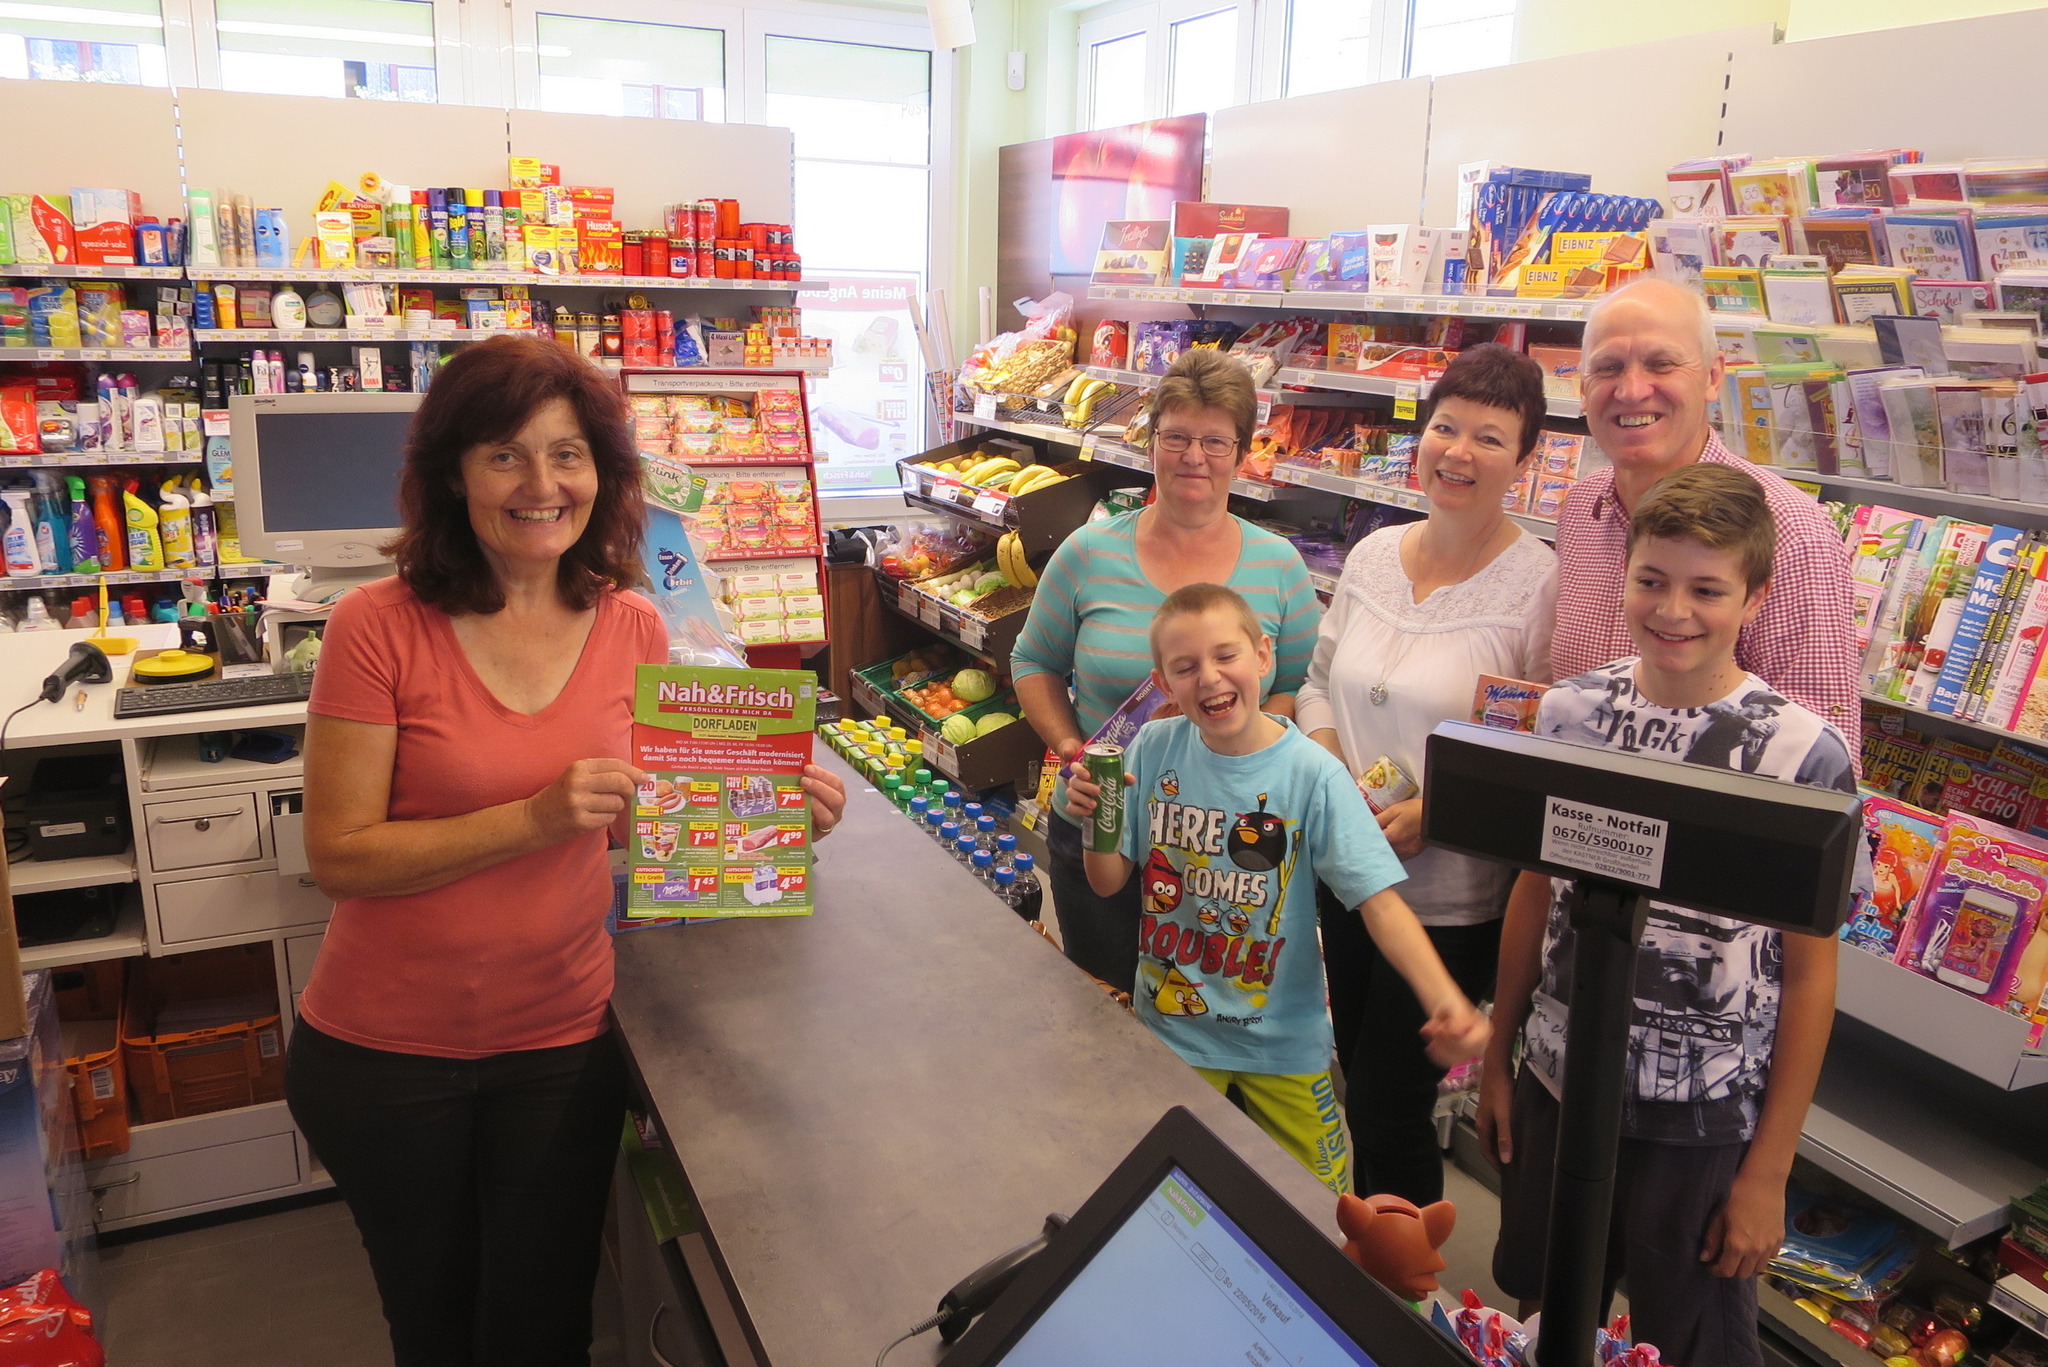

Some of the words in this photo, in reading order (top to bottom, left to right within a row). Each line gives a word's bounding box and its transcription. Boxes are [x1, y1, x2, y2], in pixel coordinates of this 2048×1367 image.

[1744, 186, 1760, 200] 55
[1863, 181, 1881, 199] 50
[1218, 210, 1246, 223] Suchard
[586, 220, 613, 231] Husch
[80, 240, 128, 249] spezial-salz
[1843, 232, 1864, 248] 85
[1933, 228, 1955, 246] 80
[2028, 230, 2048, 249] 75
[1558, 239, 1594, 253] LEIBNIZ
[1909, 244, 1935, 254] Zum
[1900, 247, 1960, 266] Geburtstag
[2001, 249, 2028, 259] Zum
[1990, 253, 2048, 273] Geburtsta
[1524, 268, 1558, 285] LEIBNIZ
[1916, 290, 1962, 309] Schuhe!
[711, 333, 715, 341] 4
[1340, 333, 1358, 343] soft
[256, 365, 267, 375] Fa
[363, 378, 380, 386] DIANA
[653, 379, 724, 388] Transportverpackung
[729, 380, 744, 388] Bitte
[1396, 405, 1415, 414] TIEFPREIS
[647, 464, 680, 484] blink
[6, 535, 25, 544] BLUE
[129, 532, 147, 540] BLUE
[130, 538, 148, 547] STAR
[7, 541, 26, 550] STAR
[761, 562, 795, 570] entfernen!
[663, 576, 694, 591] Orbit
[658, 680, 794, 708] Nah&Frisch
[1484, 684, 1543, 703] Manner
[679, 706, 724, 714] PERSÖNLICH
[725, 707, 740, 715] FÜR
[692, 717, 757, 732] DORFLADEN
[1096, 714, 1127, 749] Milka
[640, 745, 654, 753] Wir
[654, 746, 678, 754] haben
[679, 746, 691, 754] für
[691, 747, 703, 755] Sie
[726, 748, 758, 757] Geschäft
[758, 749, 805, 759] modernisiert,
[642, 753, 665, 762] damit
[666, 754, 677, 762] Sie
[678, 755, 697, 763] noch
[698, 756, 735, 766] bequemer
[736, 757, 772, 765] einkaufen
[773, 758, 803, 766] können!
[1881, 742, 1924, 770] FREIZ
[1995, 750, 2048, 777] SCHLAGE
[1879, 762, 1917, 782] dire
[1952, 768, 1969, 779] NEU
[640, 780, 655, 792] 20
[726, 781, 741, 789] HIT
[1948, 786, 1970, 796] ECHO
[691, 794, 717, 803] Gratis
[1942, 799, 1966, 811] FRAU
[1945, 793, 1961, 802] DER
[1971, 793, 2018, 819] ECHO
[1551, 802, 1594, 823] Kasse
[1607, 814, 1661, 839] Notfall
[1878, 810, 1892, 820] NEU
[1147, 800, 1225, 856] HERE
[1577, 822, 1630, 841] Rufnummer:
[1552, 825, 1654, 858] 0676/5900107
[1551, 839, 1570, 847] Wenn
[1570, 842, 1586, 851] nicht
[1586, 844, 1619, 859] erreichbar
[1620, 854, 1652, 867] außerhalb
[1573, 849, 1602, 861] KASTNER
[1602, 856, 1639, 870] Großhandel
[1594, 862, 1651, 881] 02822/9001-777
[1182, 862, 1268, 907] COMES
[1946, 858, 2042, 901] Scan-Radio
[1139, 913, 1286, 987] ROUBLE!
[1216, 1013, 1242, 1026] ANGRY
[1242, 1015, 1264, 1027] BIRDS
[1310, 1075, 1347, 1161] ISLAND
[1316, 1137, 1333, 1176] Wave
[1222, 1276, 1233, 1289] So
[1233, 1287, 1267, 1324] 22/05/2016
[1261, 1292, 1292, 1325] Verkauf
